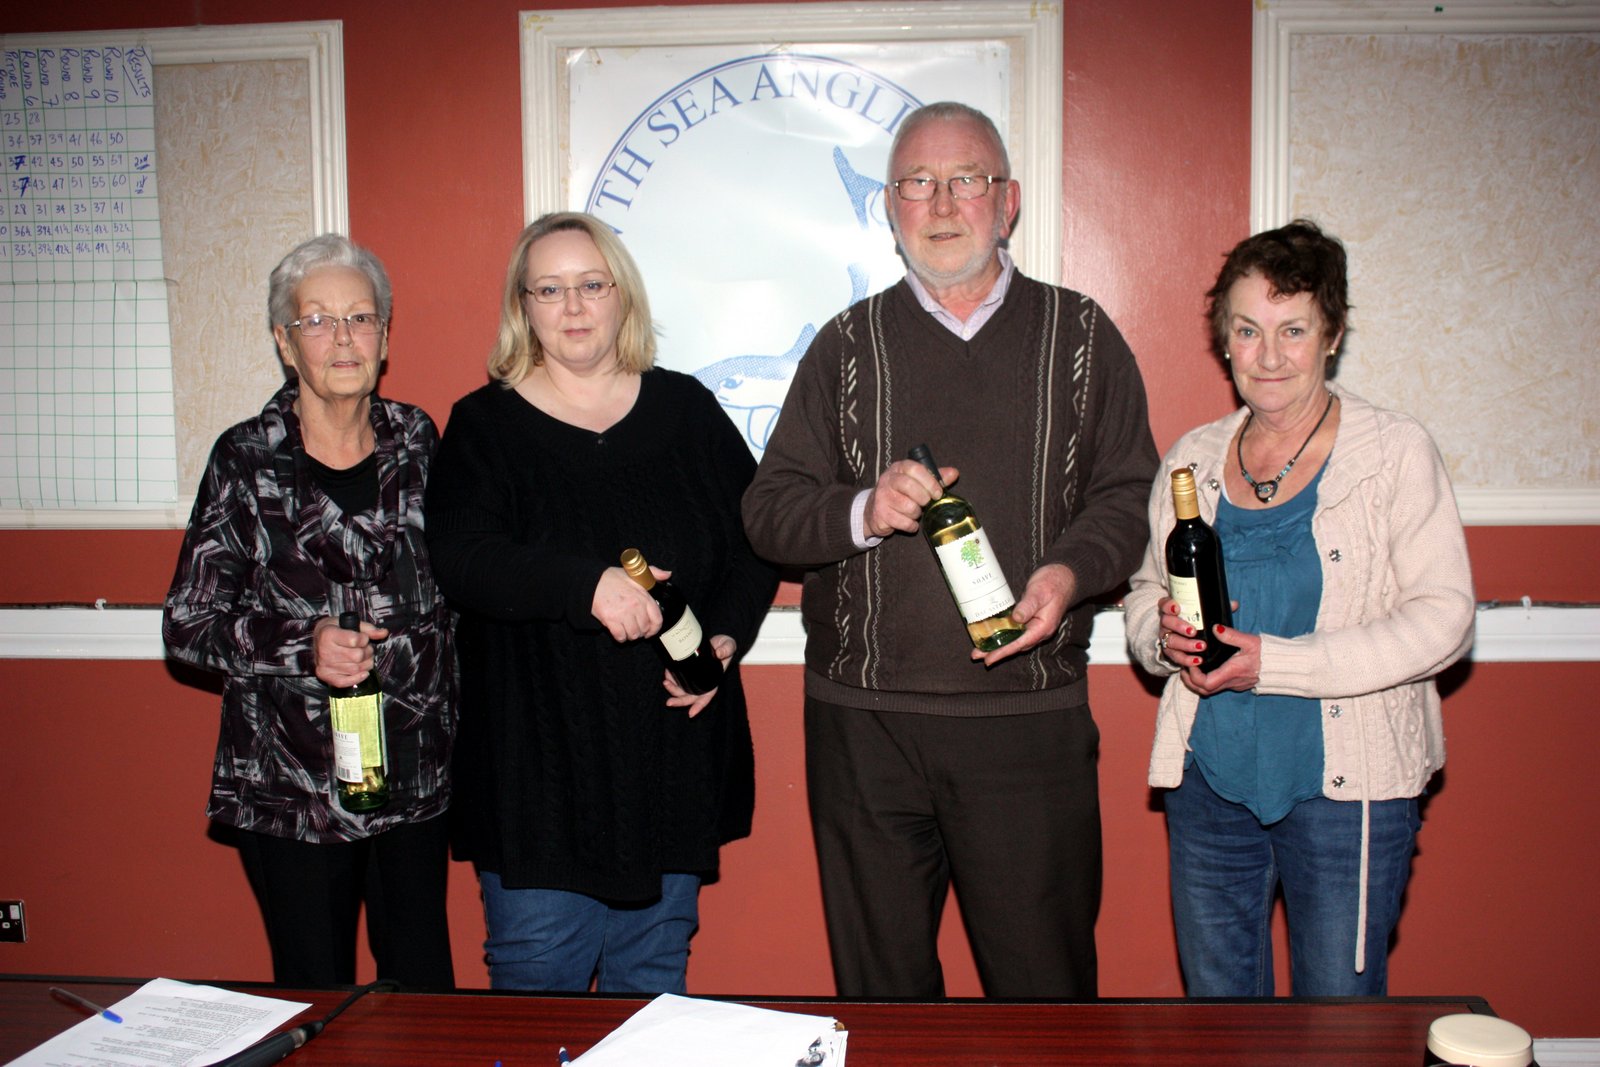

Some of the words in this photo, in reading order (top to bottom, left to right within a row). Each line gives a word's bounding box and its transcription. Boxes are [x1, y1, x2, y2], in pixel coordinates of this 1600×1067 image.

[5, 50, 19, 88] PICTURE
[125, 48, 151, 98] RESULTS
[65, 91, 79, 101] 8
[85, 89, 100, 99] 9
[104, 89, 119, 103] 10
[25, 96, 38, 106] 6
[42, 94, 59, 107] 7
[647, 76, 742, 148] SEA
[750, 63, 913, 136] ANGLI
[4, 113, 20, 125] 25
[30, 134, 42, 145] 37
[69, 134, 81, 145] 41
[90, 133, 103, 145] 46
[110, 132, 124, 144] 50
[31, 156, 42, 168] 42
[50, 156, 63, 167] 45
[71, 156, 84, 168] 50
[92, 155, 104, 166] 55
[53, 178, 64, 190] 47
[72, 176, 83, 189] 51
[92, 176, 105, 188] 55
[112, 175, 126, 188] 60
[15, 204, 27, 215] 28
[36, 204, 47, 216] 31
[74, 204, 87, 214] 35
[94, 202, 105, 214] 37
[114, 202, 124, 214] 41
